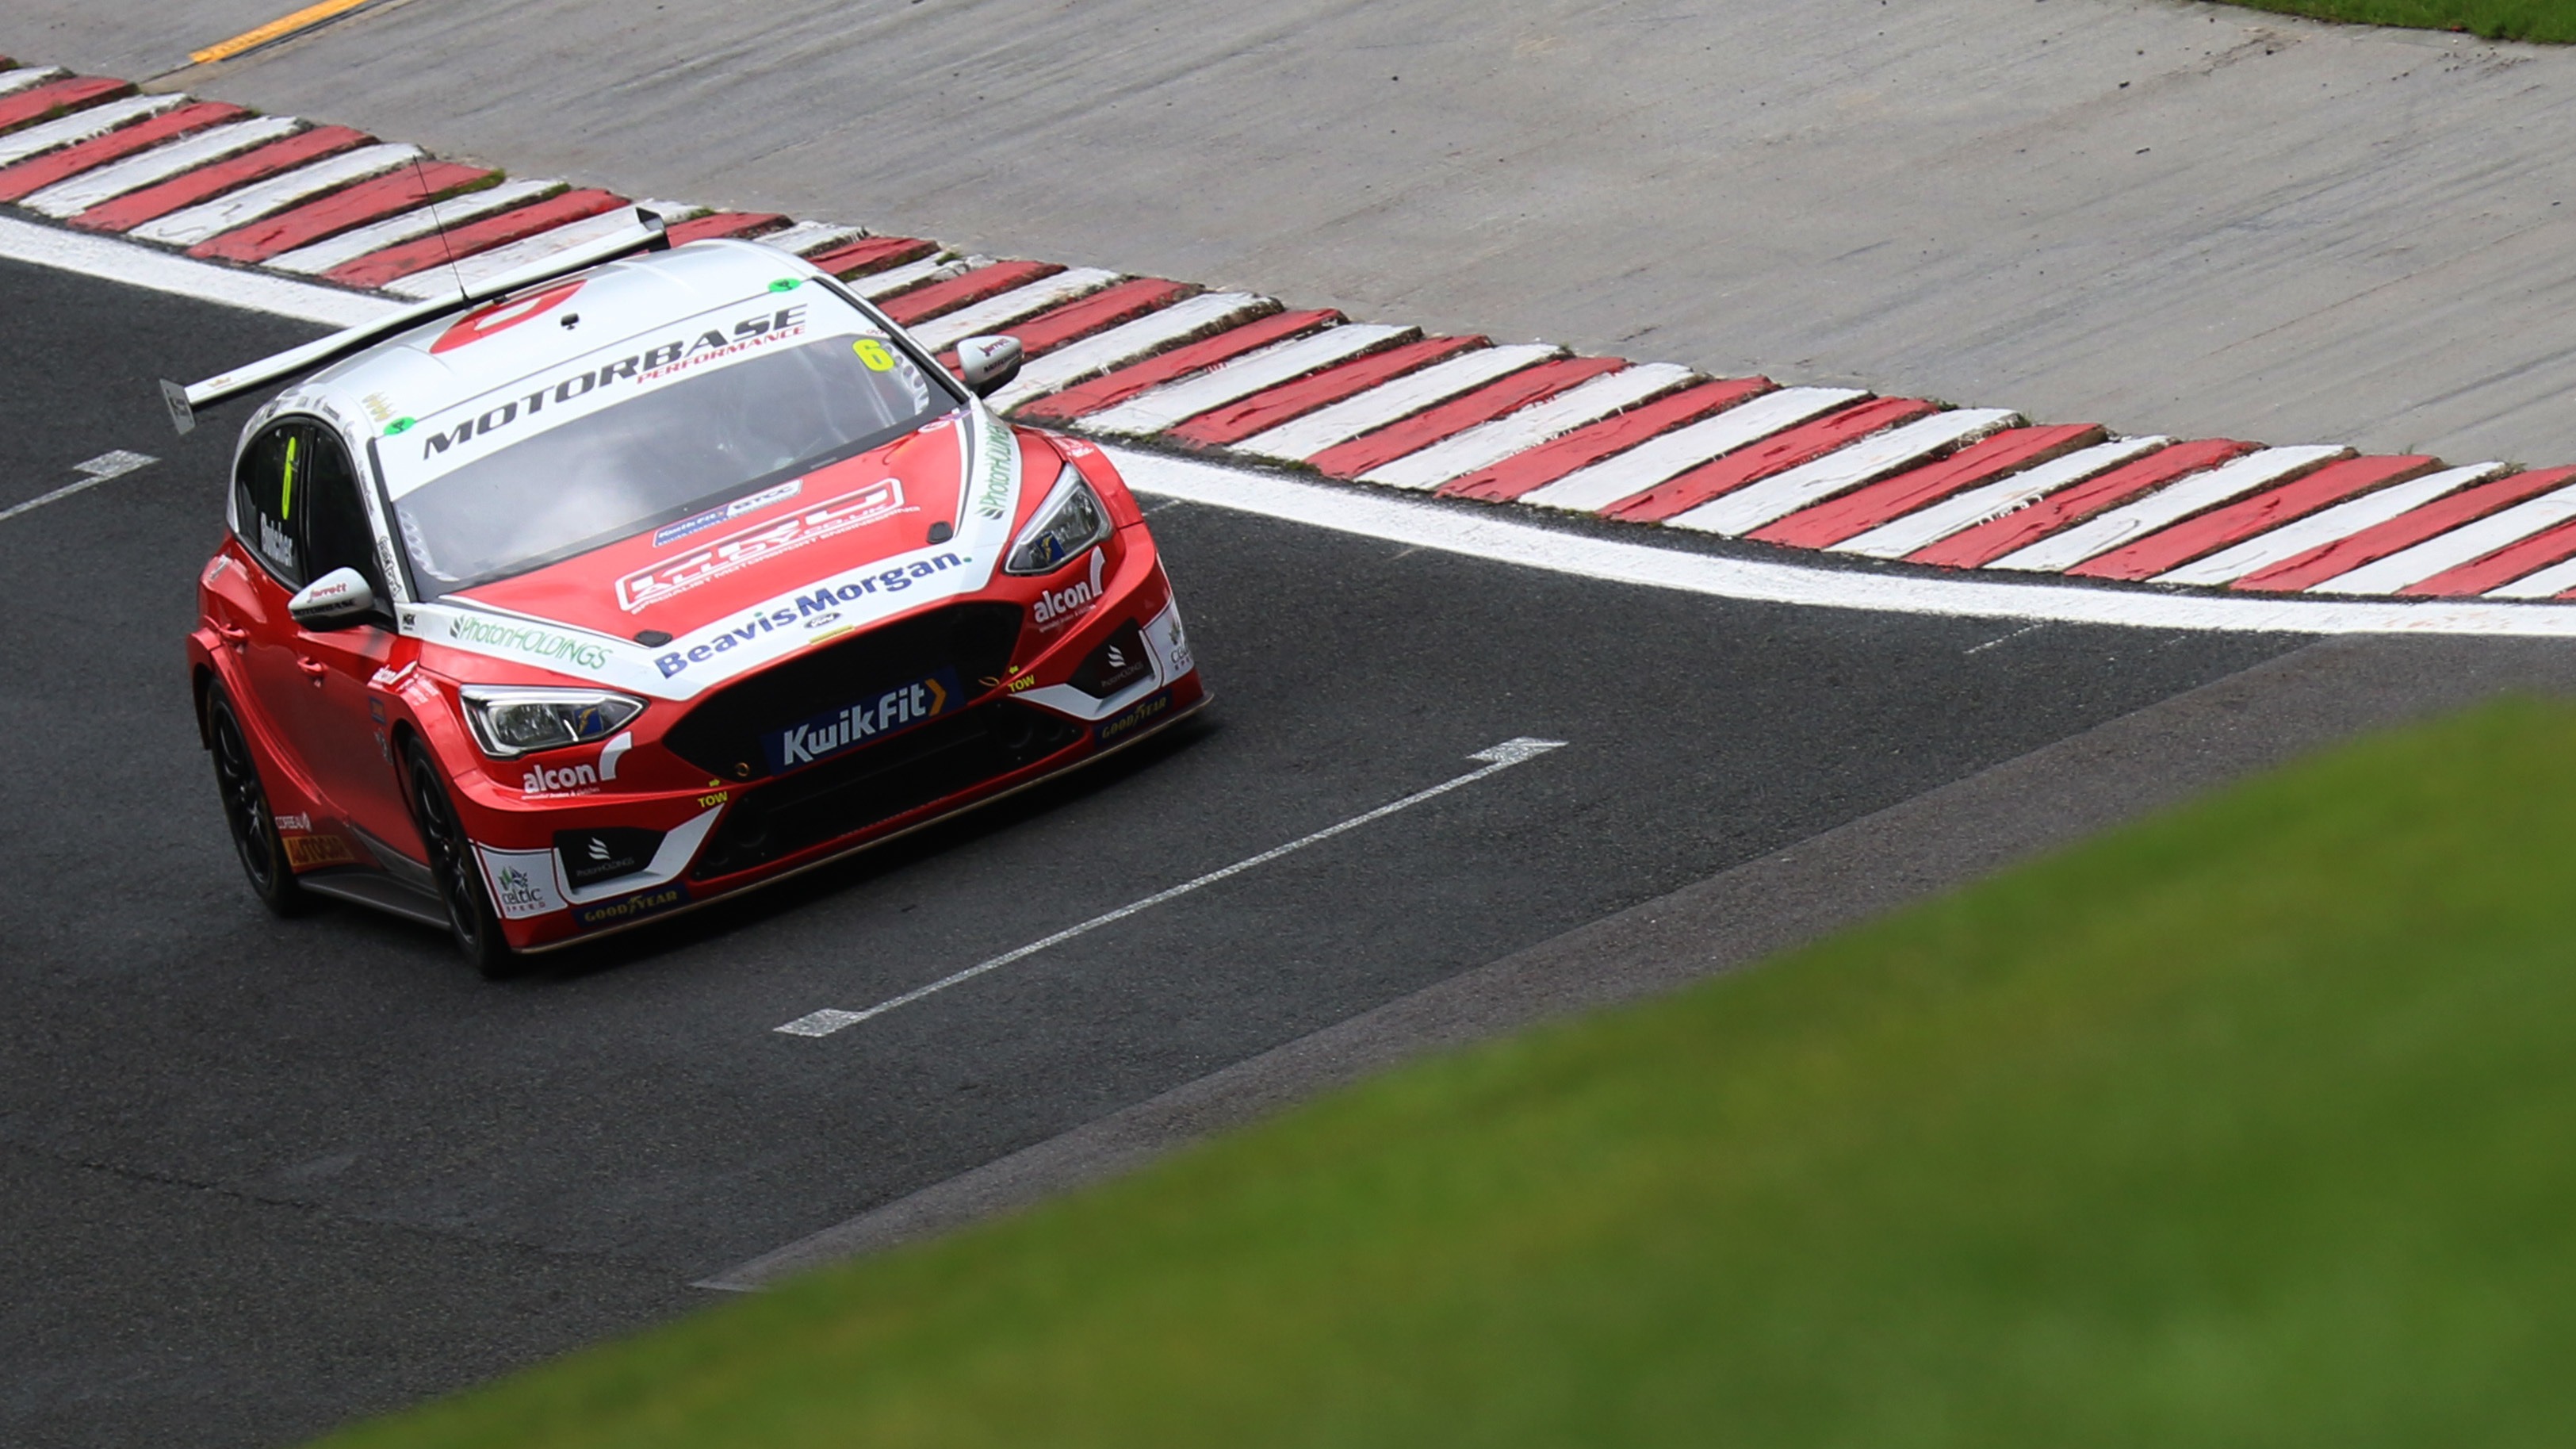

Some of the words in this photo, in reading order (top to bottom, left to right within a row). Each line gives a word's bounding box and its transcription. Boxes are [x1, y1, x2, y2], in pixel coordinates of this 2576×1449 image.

[637, 324, 806, 385] PERFORMANCE
[852, 338, 895, 372] 6
[423, 303, 808, 461] MOTORBASE
[1033, 581, 1092, 623] alcon
[460, 616, 614, 669] PhotonHOLDINGS
[1007, 674, 1035, 693] TOW
[523, 764, 597, 794] alcon
[698, 790, 728, 808] TOW
[584, 890, 678, 923] GOODYEAR
